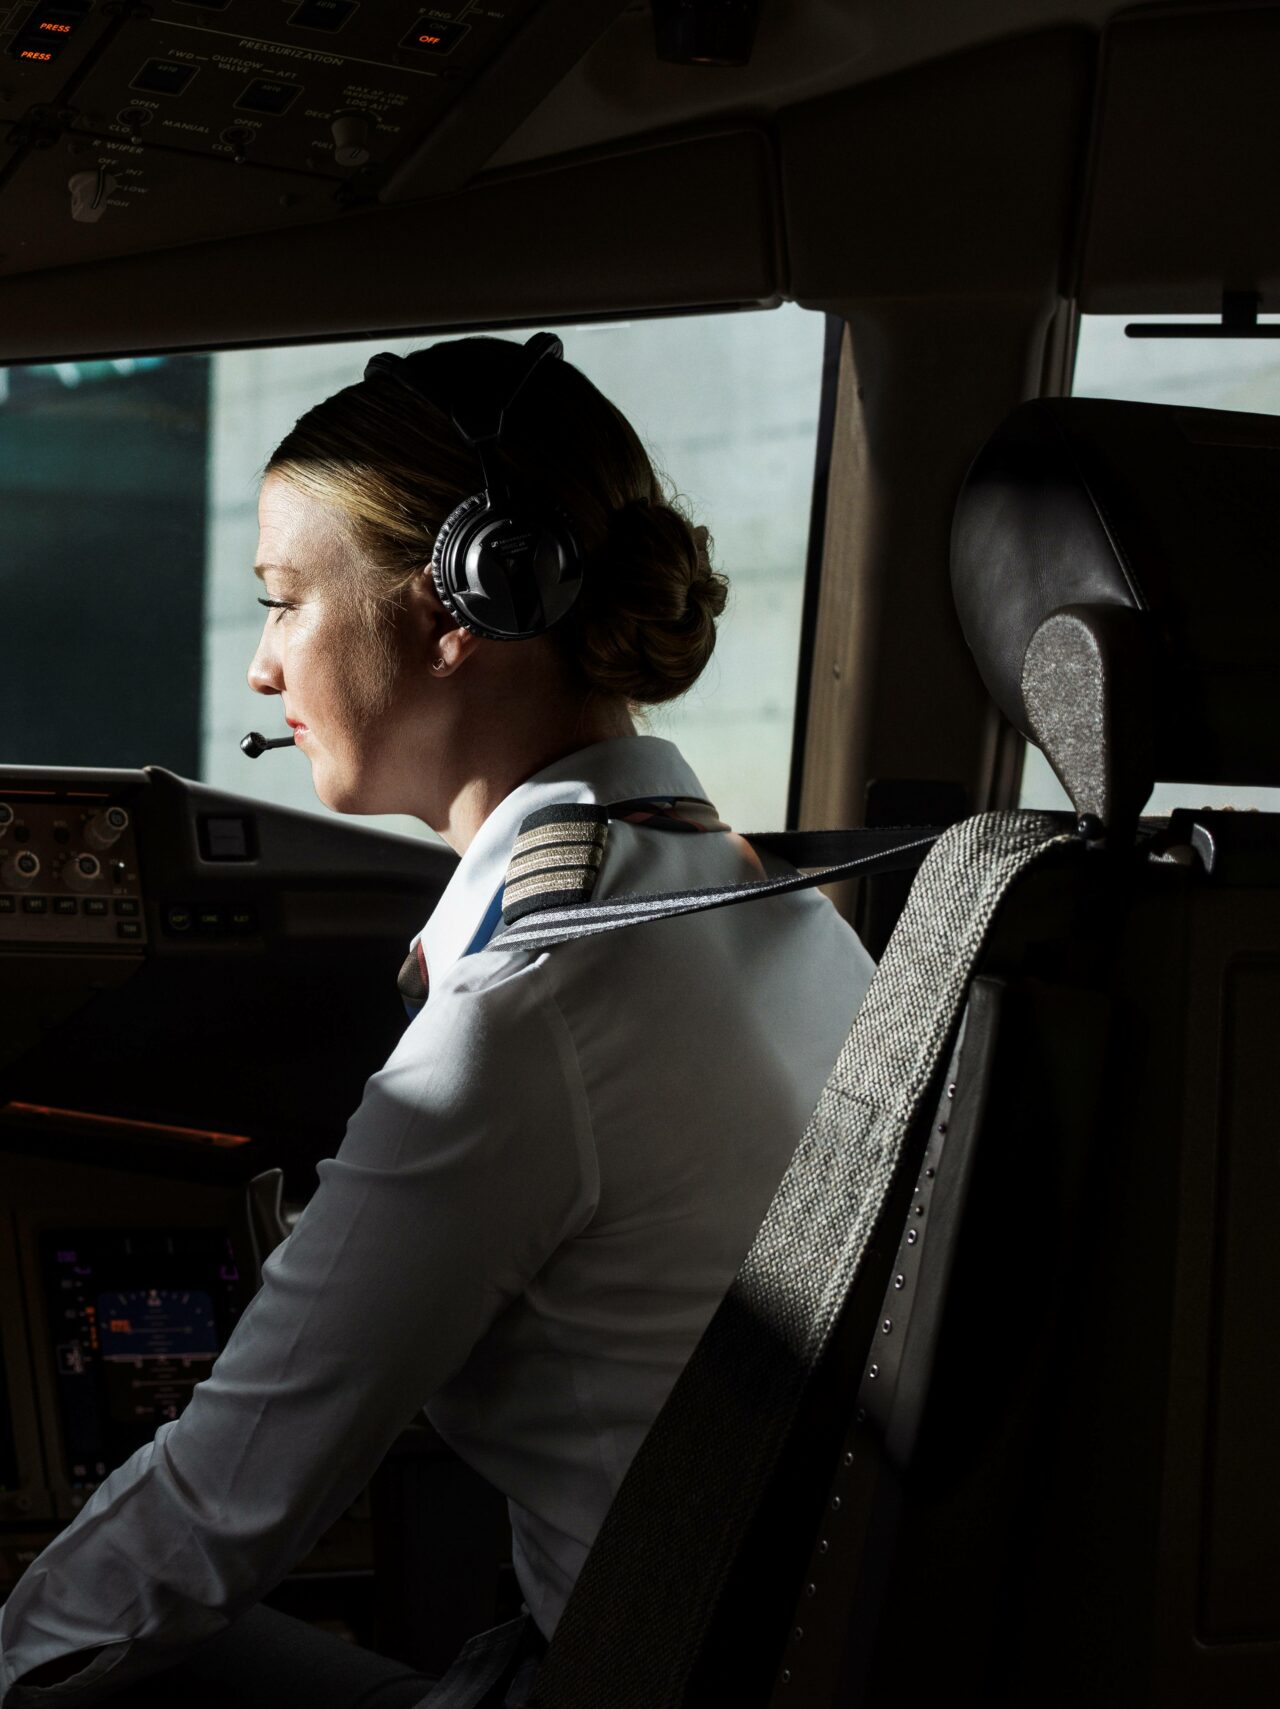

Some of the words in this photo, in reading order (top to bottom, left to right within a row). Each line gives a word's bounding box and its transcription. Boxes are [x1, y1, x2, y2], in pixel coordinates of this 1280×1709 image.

[39, 22, 71, 33] PRESS
[419, 35, 441, 44] OFF
[20, 50, 53, 61] PRESS
[239, 38, 345, 67] PRESSURIZATION
[168, 49, 195, 60] FWD
[212, 54, 265, 70] OUTFLOW
[162, 119, 209, 134] MANUAL
